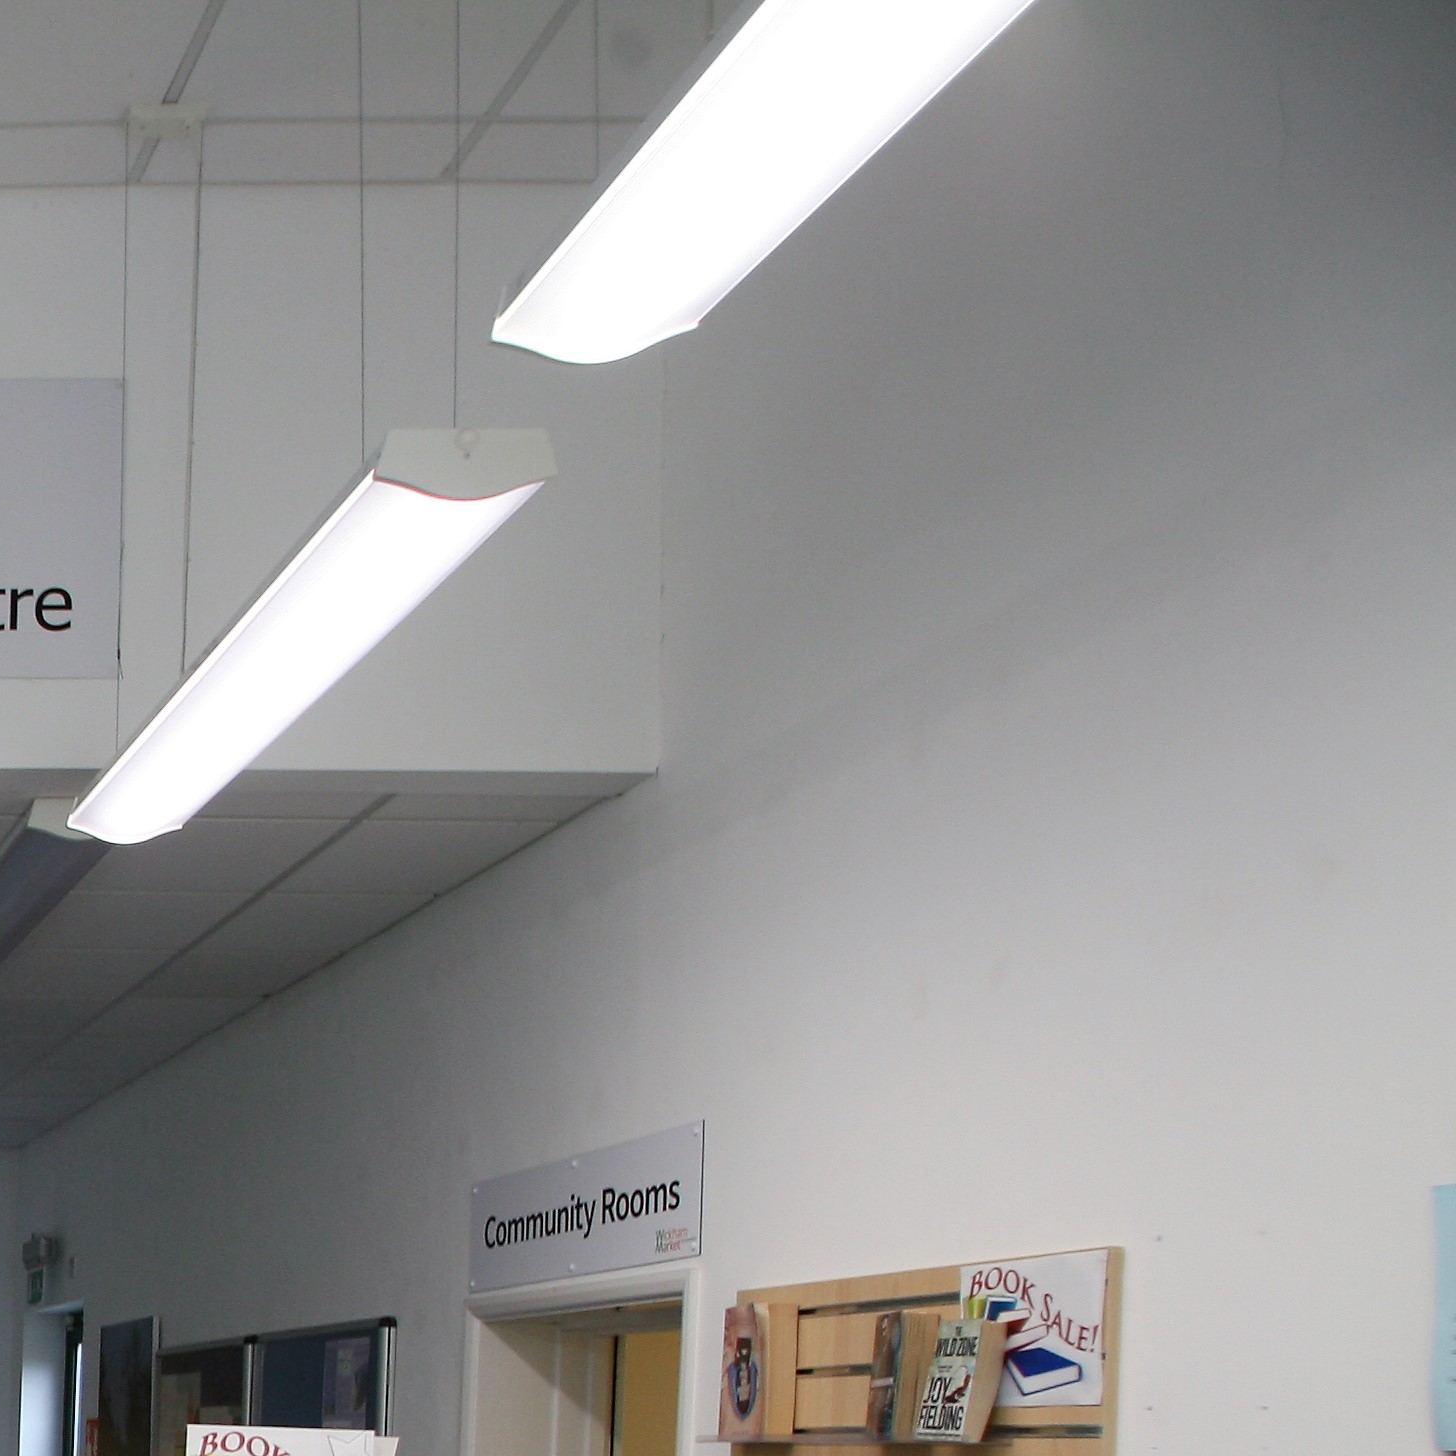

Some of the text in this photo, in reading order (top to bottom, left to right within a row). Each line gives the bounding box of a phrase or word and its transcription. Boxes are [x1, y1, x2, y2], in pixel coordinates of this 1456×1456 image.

[483, 1178, 681, 1250] Community Rooms
[969, 1267, 1099, 1352] BOOK SALE!
[923, 1377, 953, 1404] JOY
[919, 1405, 964, 1432] FIELDING
